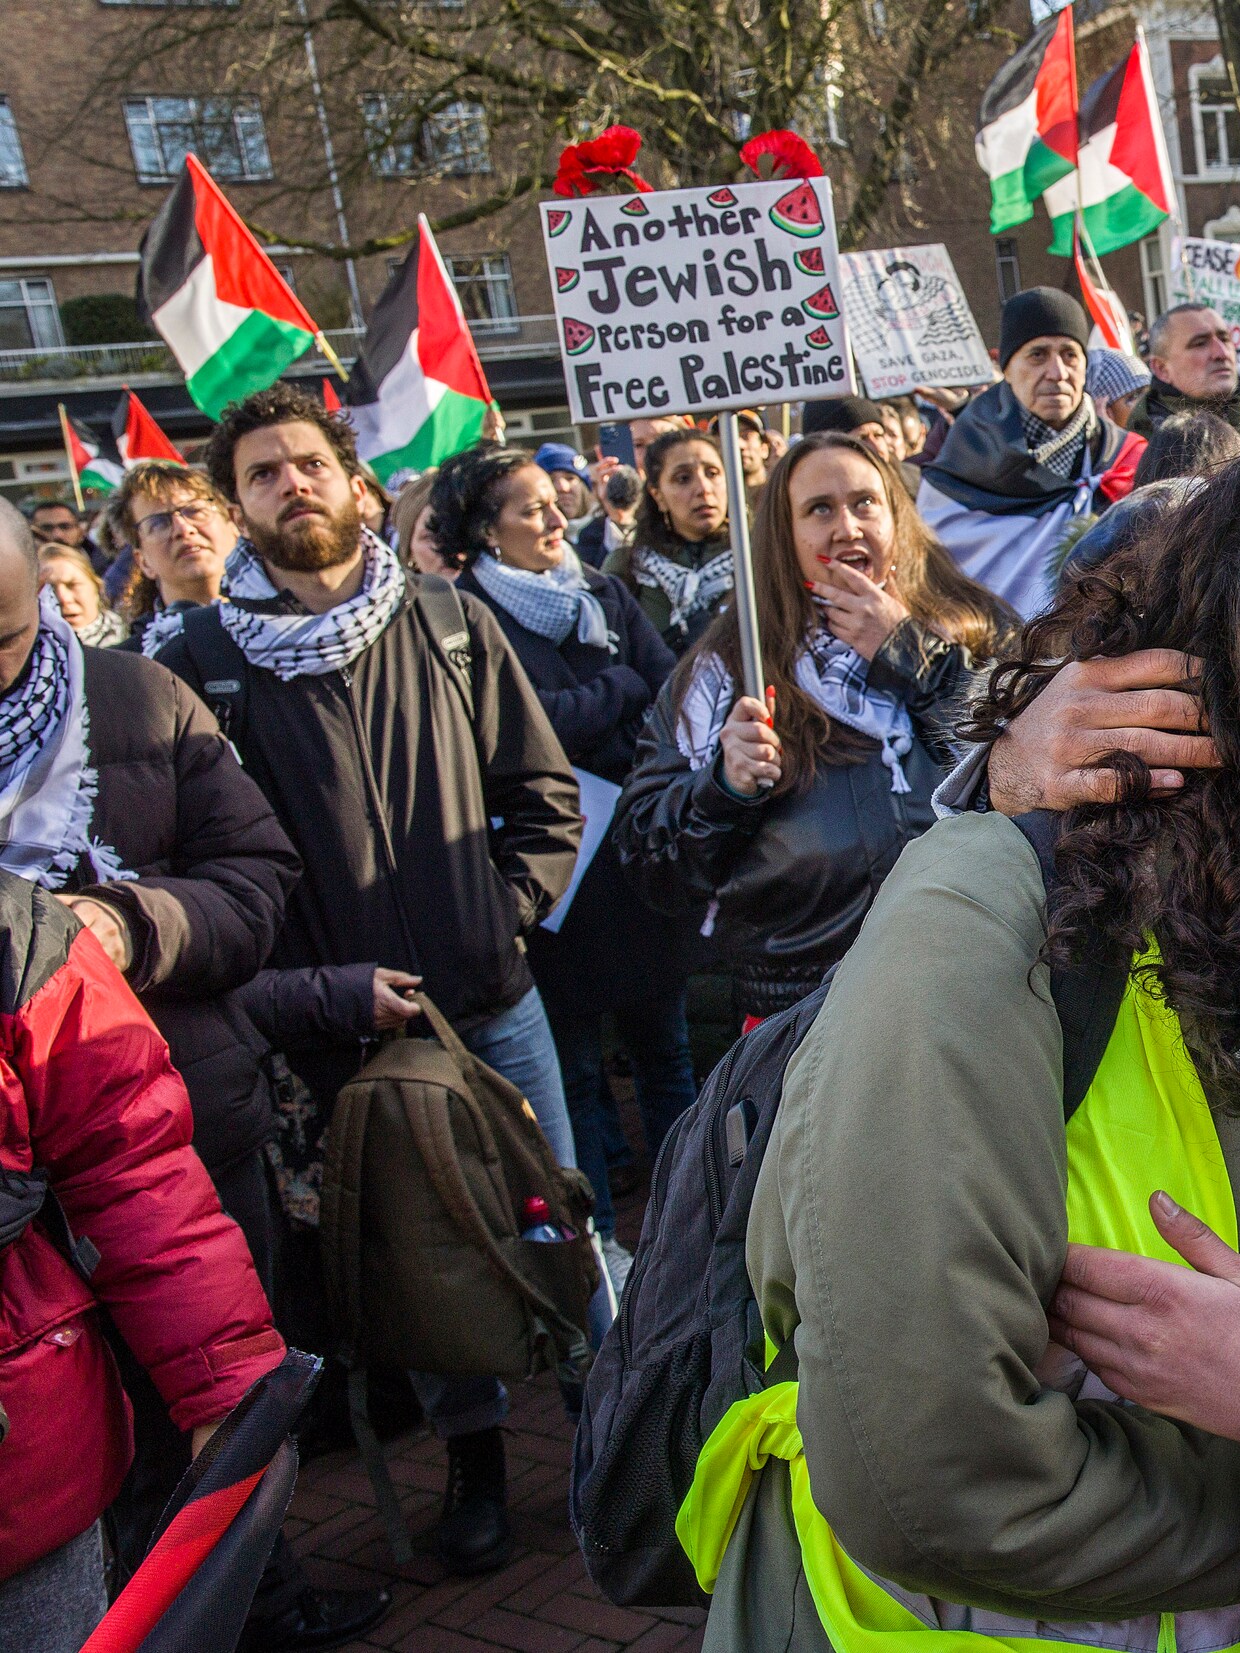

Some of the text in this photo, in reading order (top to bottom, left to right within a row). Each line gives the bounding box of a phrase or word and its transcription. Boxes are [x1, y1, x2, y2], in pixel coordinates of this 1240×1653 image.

[580, 203, 761, 253] Another
[583, 238, 792, 314] Jewish
[718, 304, 773, 336] for
[781, 306, 805, 326] a
[574, 342, 844, 417] Free Palestine
[879, 350, 964, 368] SAVE GAZA,
[871, 374, 906, 390] STOP
